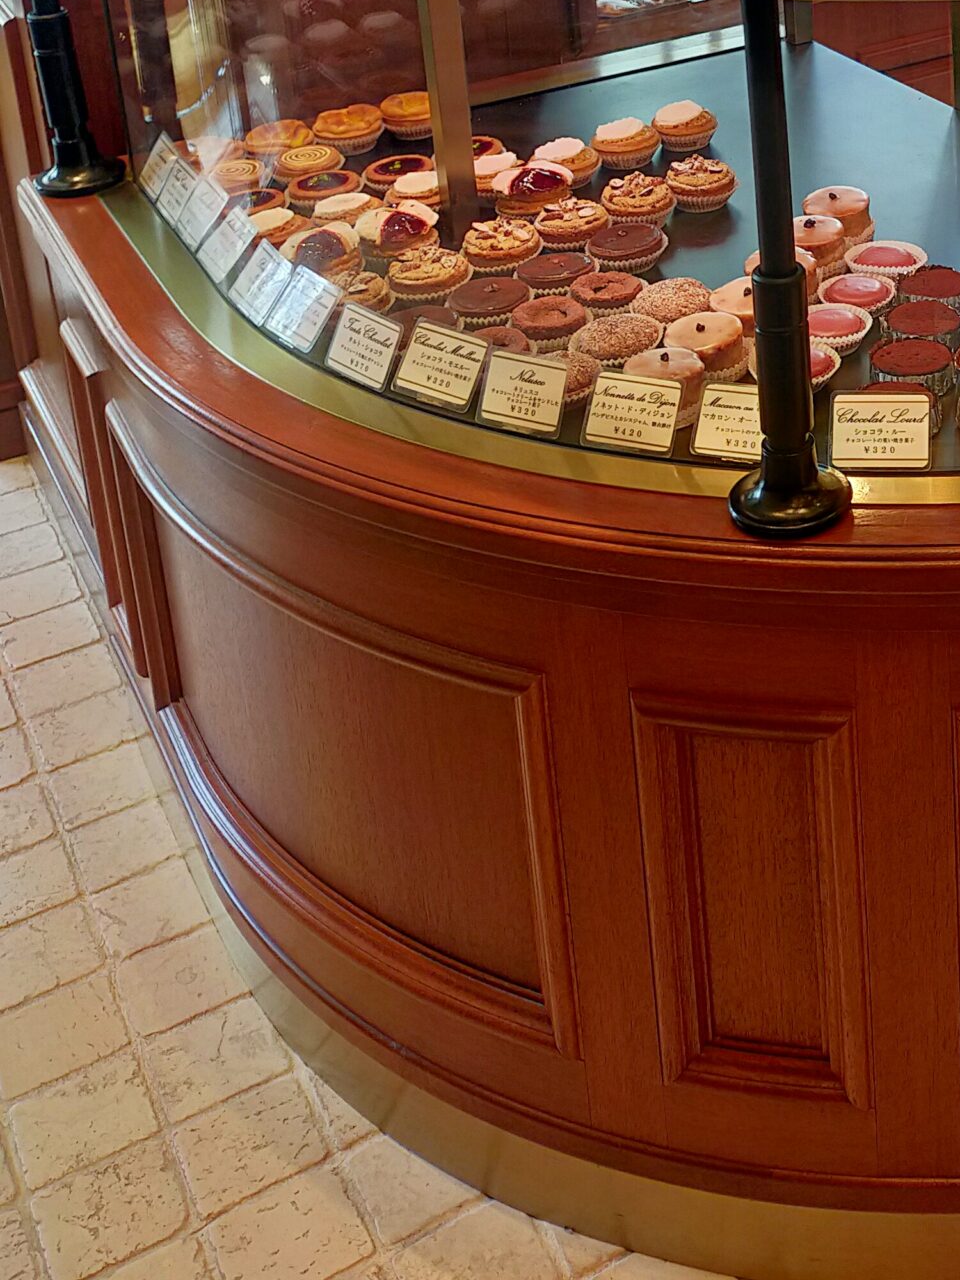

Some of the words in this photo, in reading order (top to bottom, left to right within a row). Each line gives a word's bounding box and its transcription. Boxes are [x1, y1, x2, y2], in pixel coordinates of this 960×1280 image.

[363, 324, 393, 350] Chocolat
[413, 331, 445, 353] Chocolat
[420, 352, 471, 371] ショコラ・モエルー
[426, 375, 451, 388] ¥320
[595, 385, 635, 401] Nonnette
[636, 391, 646, 402] de
[647, 391, 677, 409] Dijon
[704, 396, 741, 411] Macaron
[510, 405, 536, 417] ¥320
[594, 401, 674, 419] ノネット・ド・ディジョン
[836, 408, 886, 424] Chocolat
[886, 408, 929, 424] Lourd
[613, 426, 643, 438] ¥420
[854, 427, 906, 436] ショコラ・ルー
[726, 438, 756, 449] ¥320
[864, 445, 896, 454] ¥320
